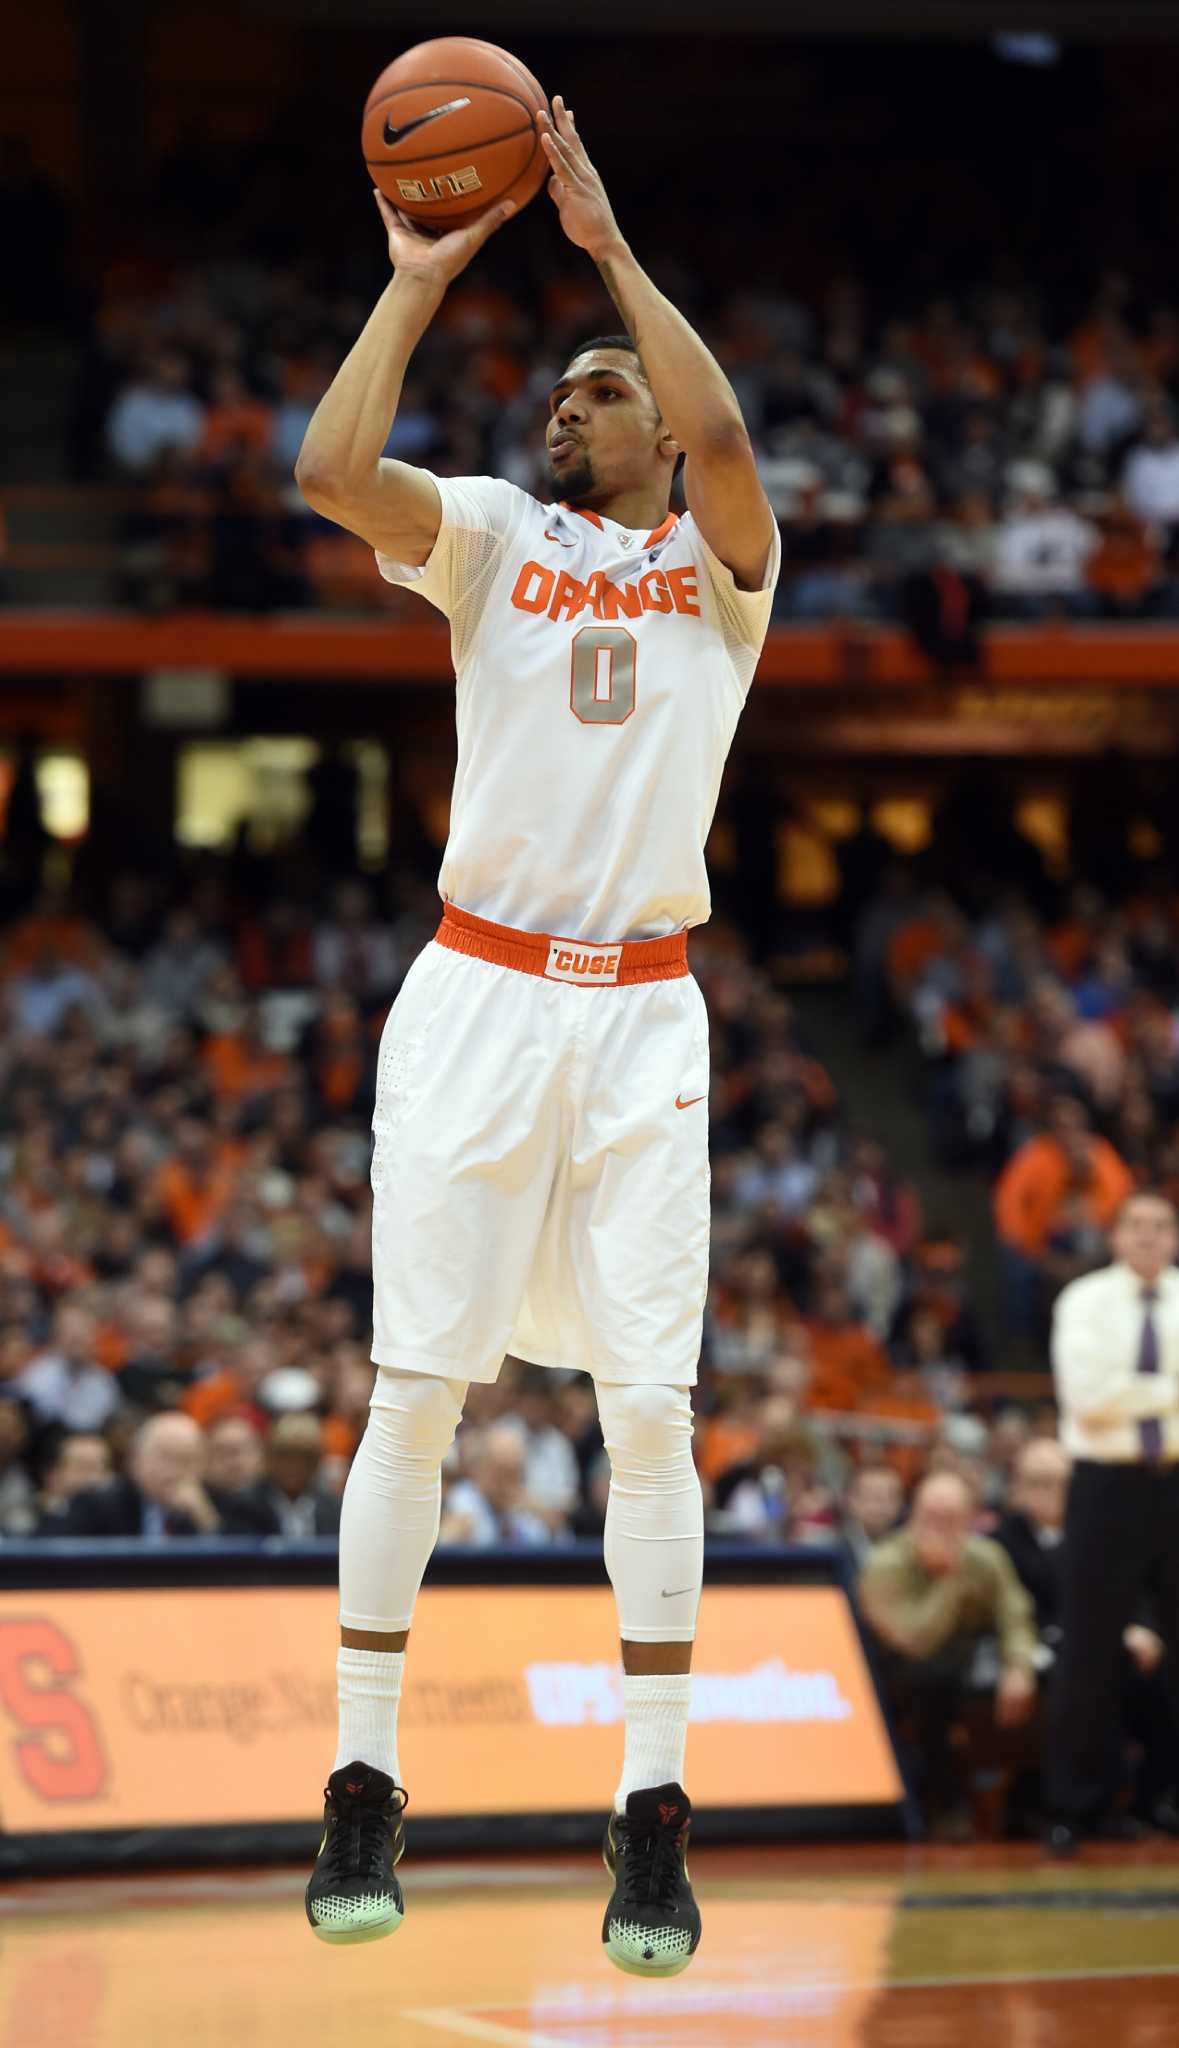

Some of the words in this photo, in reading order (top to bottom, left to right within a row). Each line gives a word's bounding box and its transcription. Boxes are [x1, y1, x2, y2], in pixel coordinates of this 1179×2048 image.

[396, 165, 482, 202] ELITE
[511, 560, 702, 622] ORANGE
[570, 626, 637, 725] 0
